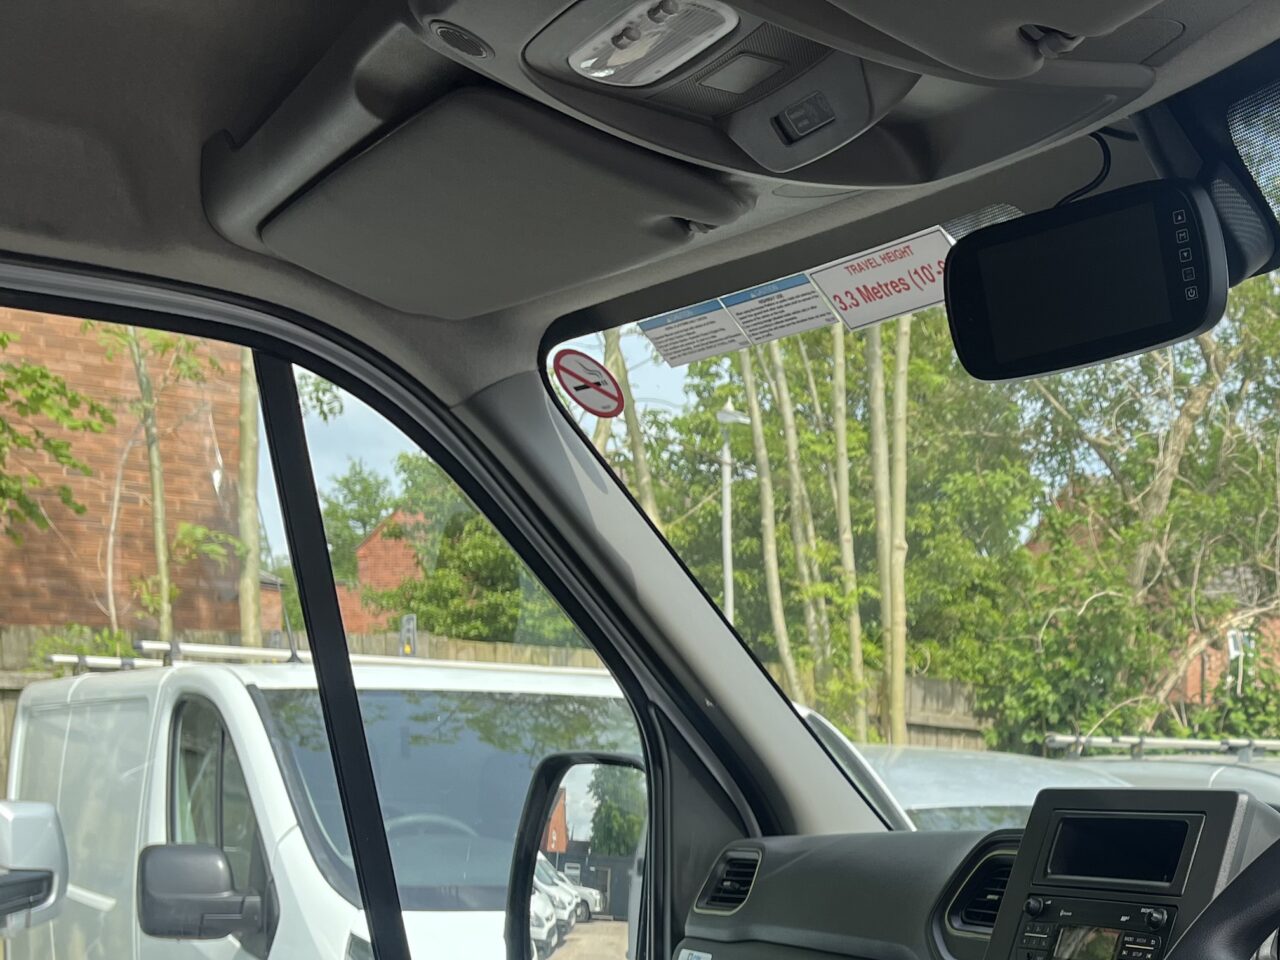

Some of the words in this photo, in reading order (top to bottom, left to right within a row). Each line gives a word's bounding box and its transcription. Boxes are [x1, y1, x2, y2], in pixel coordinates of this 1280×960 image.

[844, 256, 882, 276] TRAVEL
[879, 244, 914, 264] HEIGHT
[833, 290, 860, 311] 3.3
[855, 277, 911, 304] Metres
